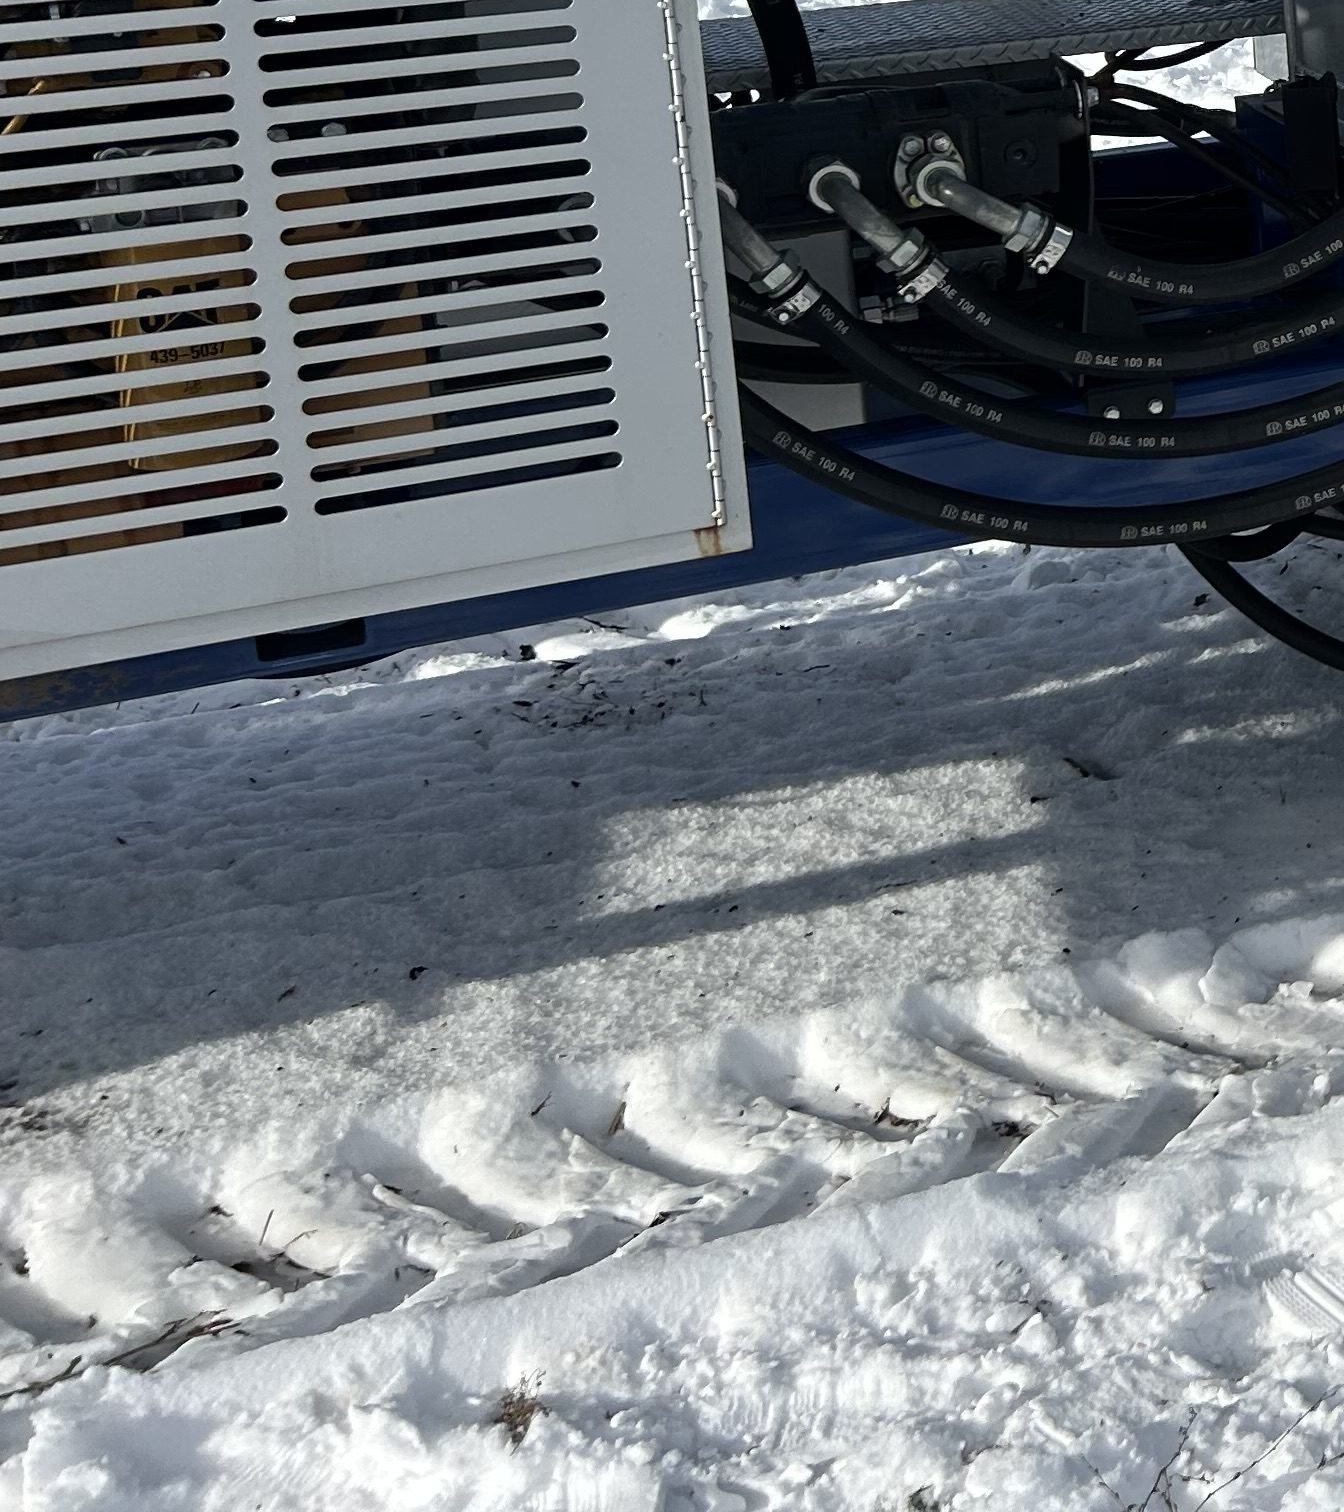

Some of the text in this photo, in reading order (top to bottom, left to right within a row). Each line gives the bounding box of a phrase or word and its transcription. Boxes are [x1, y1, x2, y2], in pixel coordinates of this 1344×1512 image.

[1301, 250, 1323, 269] SAE
[1325, 240, 1343, 254] 100
[1127, 272, 1193, 294] SAE 100 R4
[936, 279, 992, 327] SAE 100 R4
[818, 304, 850, 336] 100 R4
[1272, 316, 1336, 348] SAE 100 R4
[1095, 355, 1163, 368] SAE 100 R4
[938, 390, 1002, 424] SAE 100 R4
[1285, 416, 1308, 431] SAE
[1312, 409, 1330, 422] 100
[1109, 435, 1175, 448] SAE 100 R4
[791, 442, 856, 481] SAE 100 R4
[1314, 488, 1337, 503] SAE
[961, 511, 1028, 532] SAE 100 R4
[1141, 520, 1207, 536] SAE 100 R4
